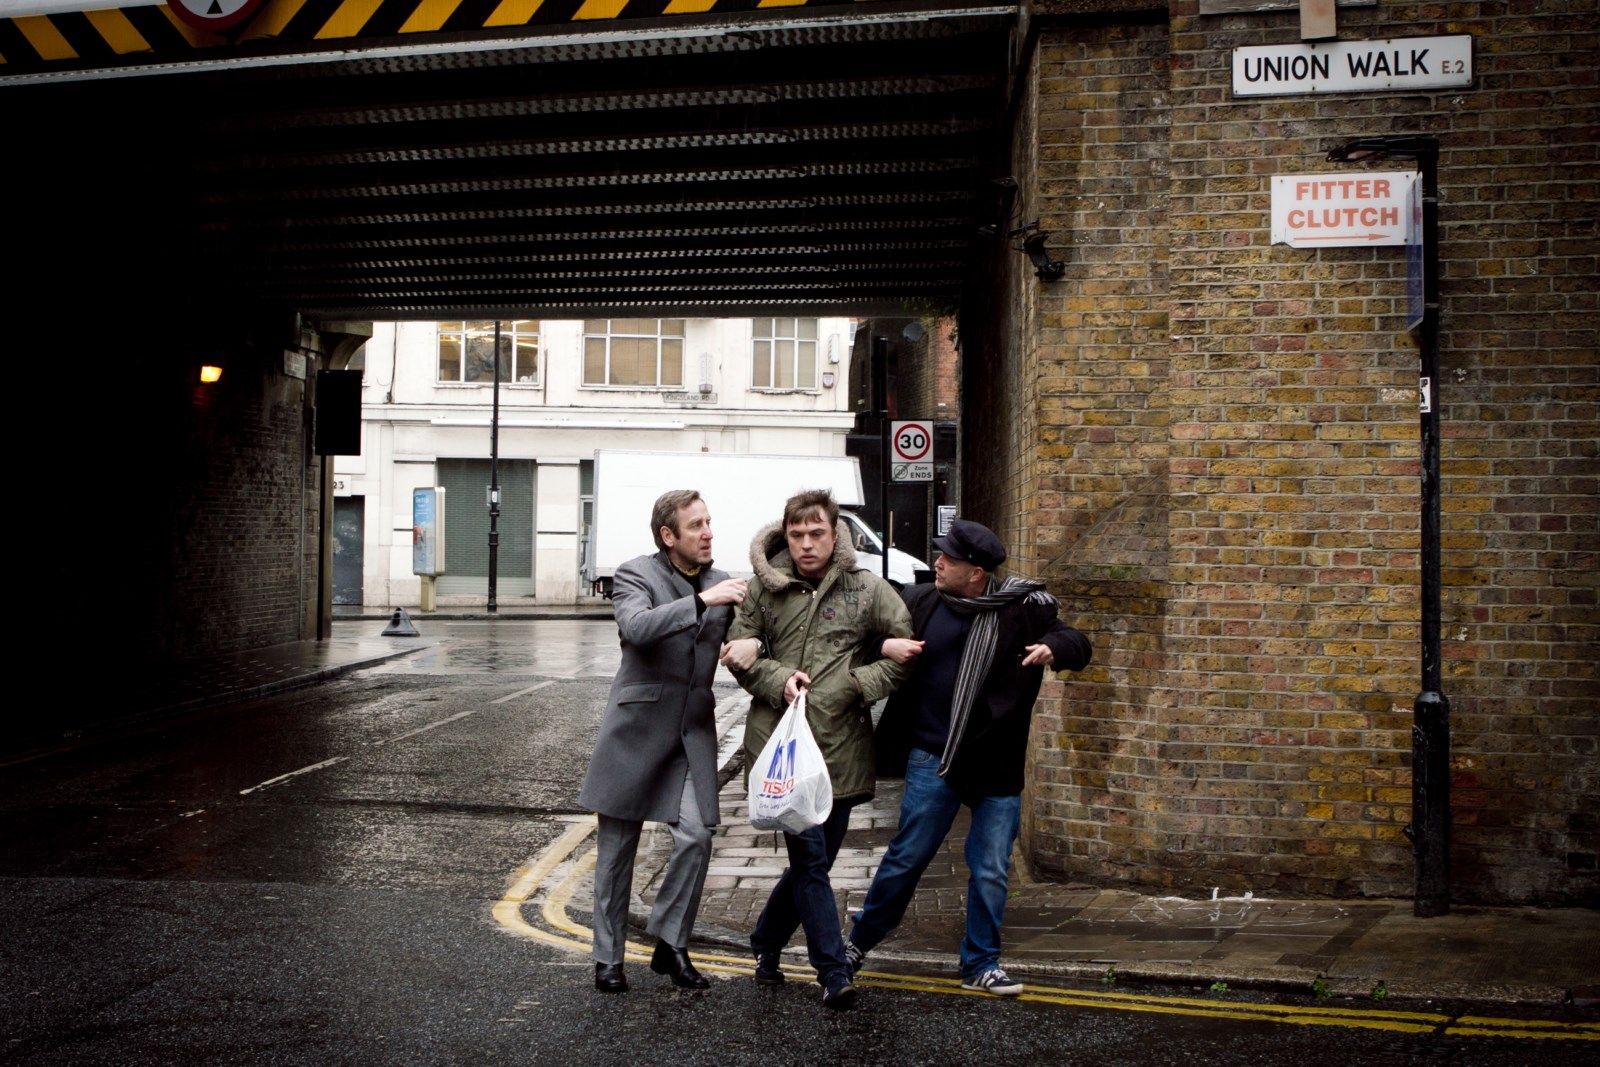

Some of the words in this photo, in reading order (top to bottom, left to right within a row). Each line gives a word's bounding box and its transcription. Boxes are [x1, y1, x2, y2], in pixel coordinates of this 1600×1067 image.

[1244, 54, 1329, 82] UNION
[1347, 48, 1430, 78] WALK
[1441, 60, 1465, 75] E.2
[1295, 179, 1391, 201] FITTER
[1287, 207, 1399, 229] CLUTCH
[900, 434, 925, 449] 30
[910, 471, 932, 479] ENDS
